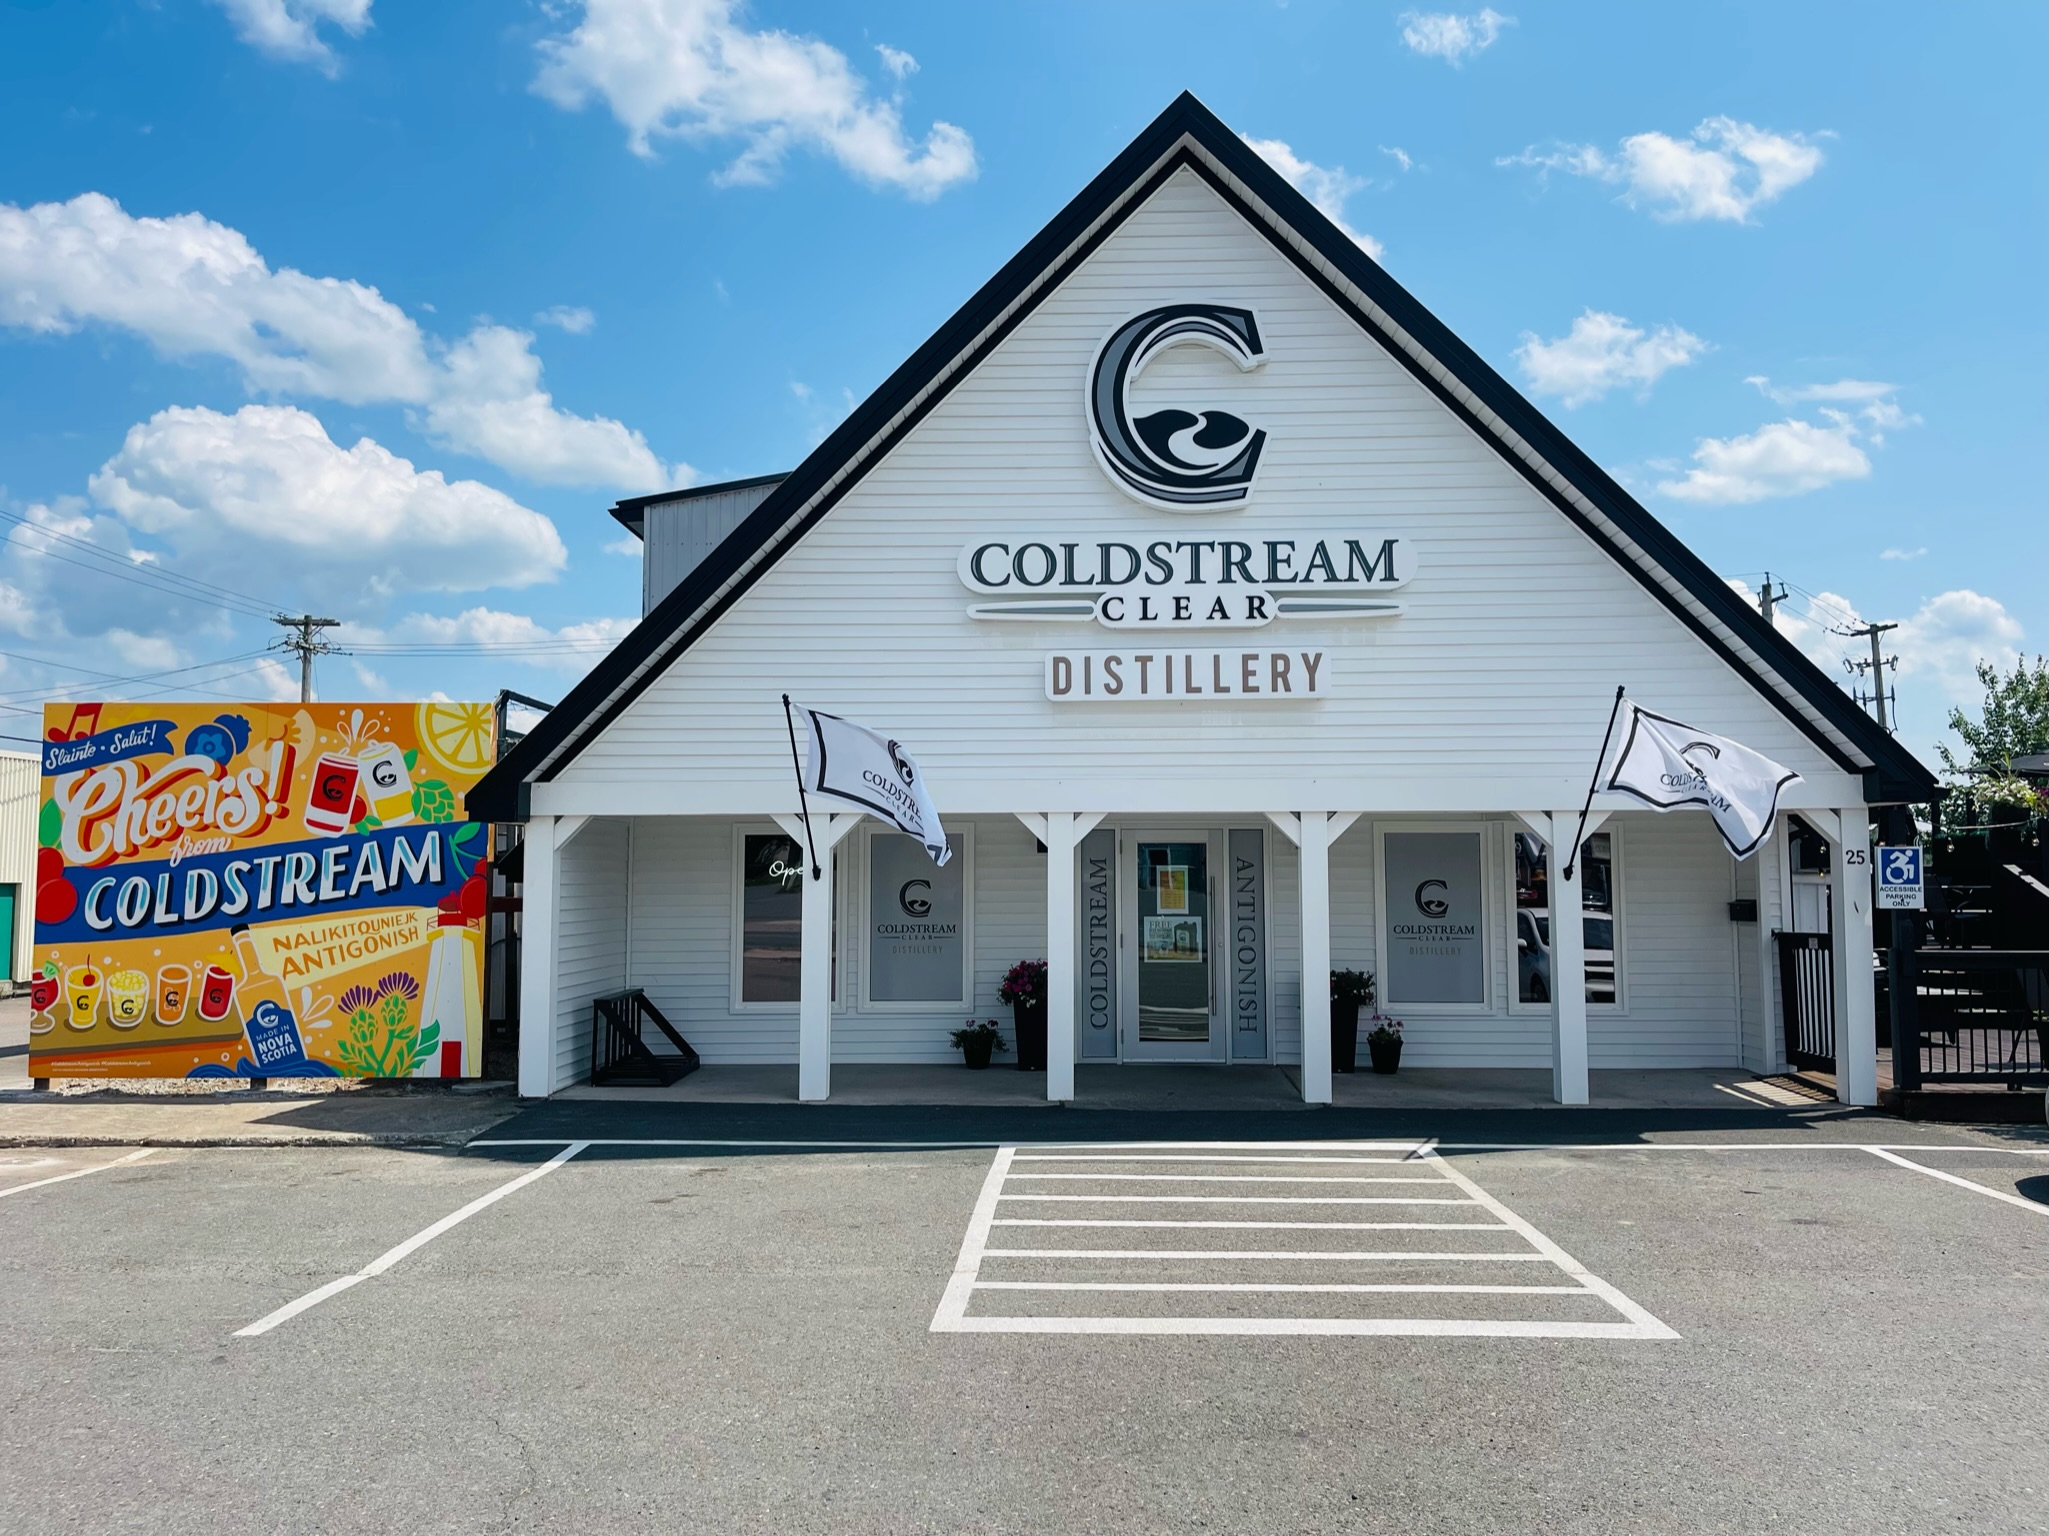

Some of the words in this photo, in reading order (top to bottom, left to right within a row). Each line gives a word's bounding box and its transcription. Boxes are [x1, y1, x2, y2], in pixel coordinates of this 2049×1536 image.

[970, 538, 1400, 587] COLDSTREAM
[1100, 595, 1270, 621] CLEAR
[1052, 652, 1323, 695] DISTILLERY
[109, 723, 157, 755] Salut!
[54, 740, 292, 865] Cheers!
[169, 834, 232, 867] from
[1845, 850, 1865, 865] 25
[84, 830, 442, 930] COLDSTREAM
[769, 860, 803, 886] Ope
[877, 924, 956, 934] COLDSTREAM
[1393, 924, 1475, 935] COLDSTREAM
[282, 926, 419, 981] ANTIGONISH
[892, 945, 943, 954] DISTILLERY
[1090, 857, 1109, 1031] COLDSTREAM
[1236, 856, 1258, 1033] ANTIGONISH
[1409, 946, 1461, 955] DISTILLERY
[256, 1028, 278, 1041] MADE
[280, 1024, 290, 1032] IN
[258, 1033, 293, 1054] NOVA
[262, 1044, 297, 1064] SCOTIA
